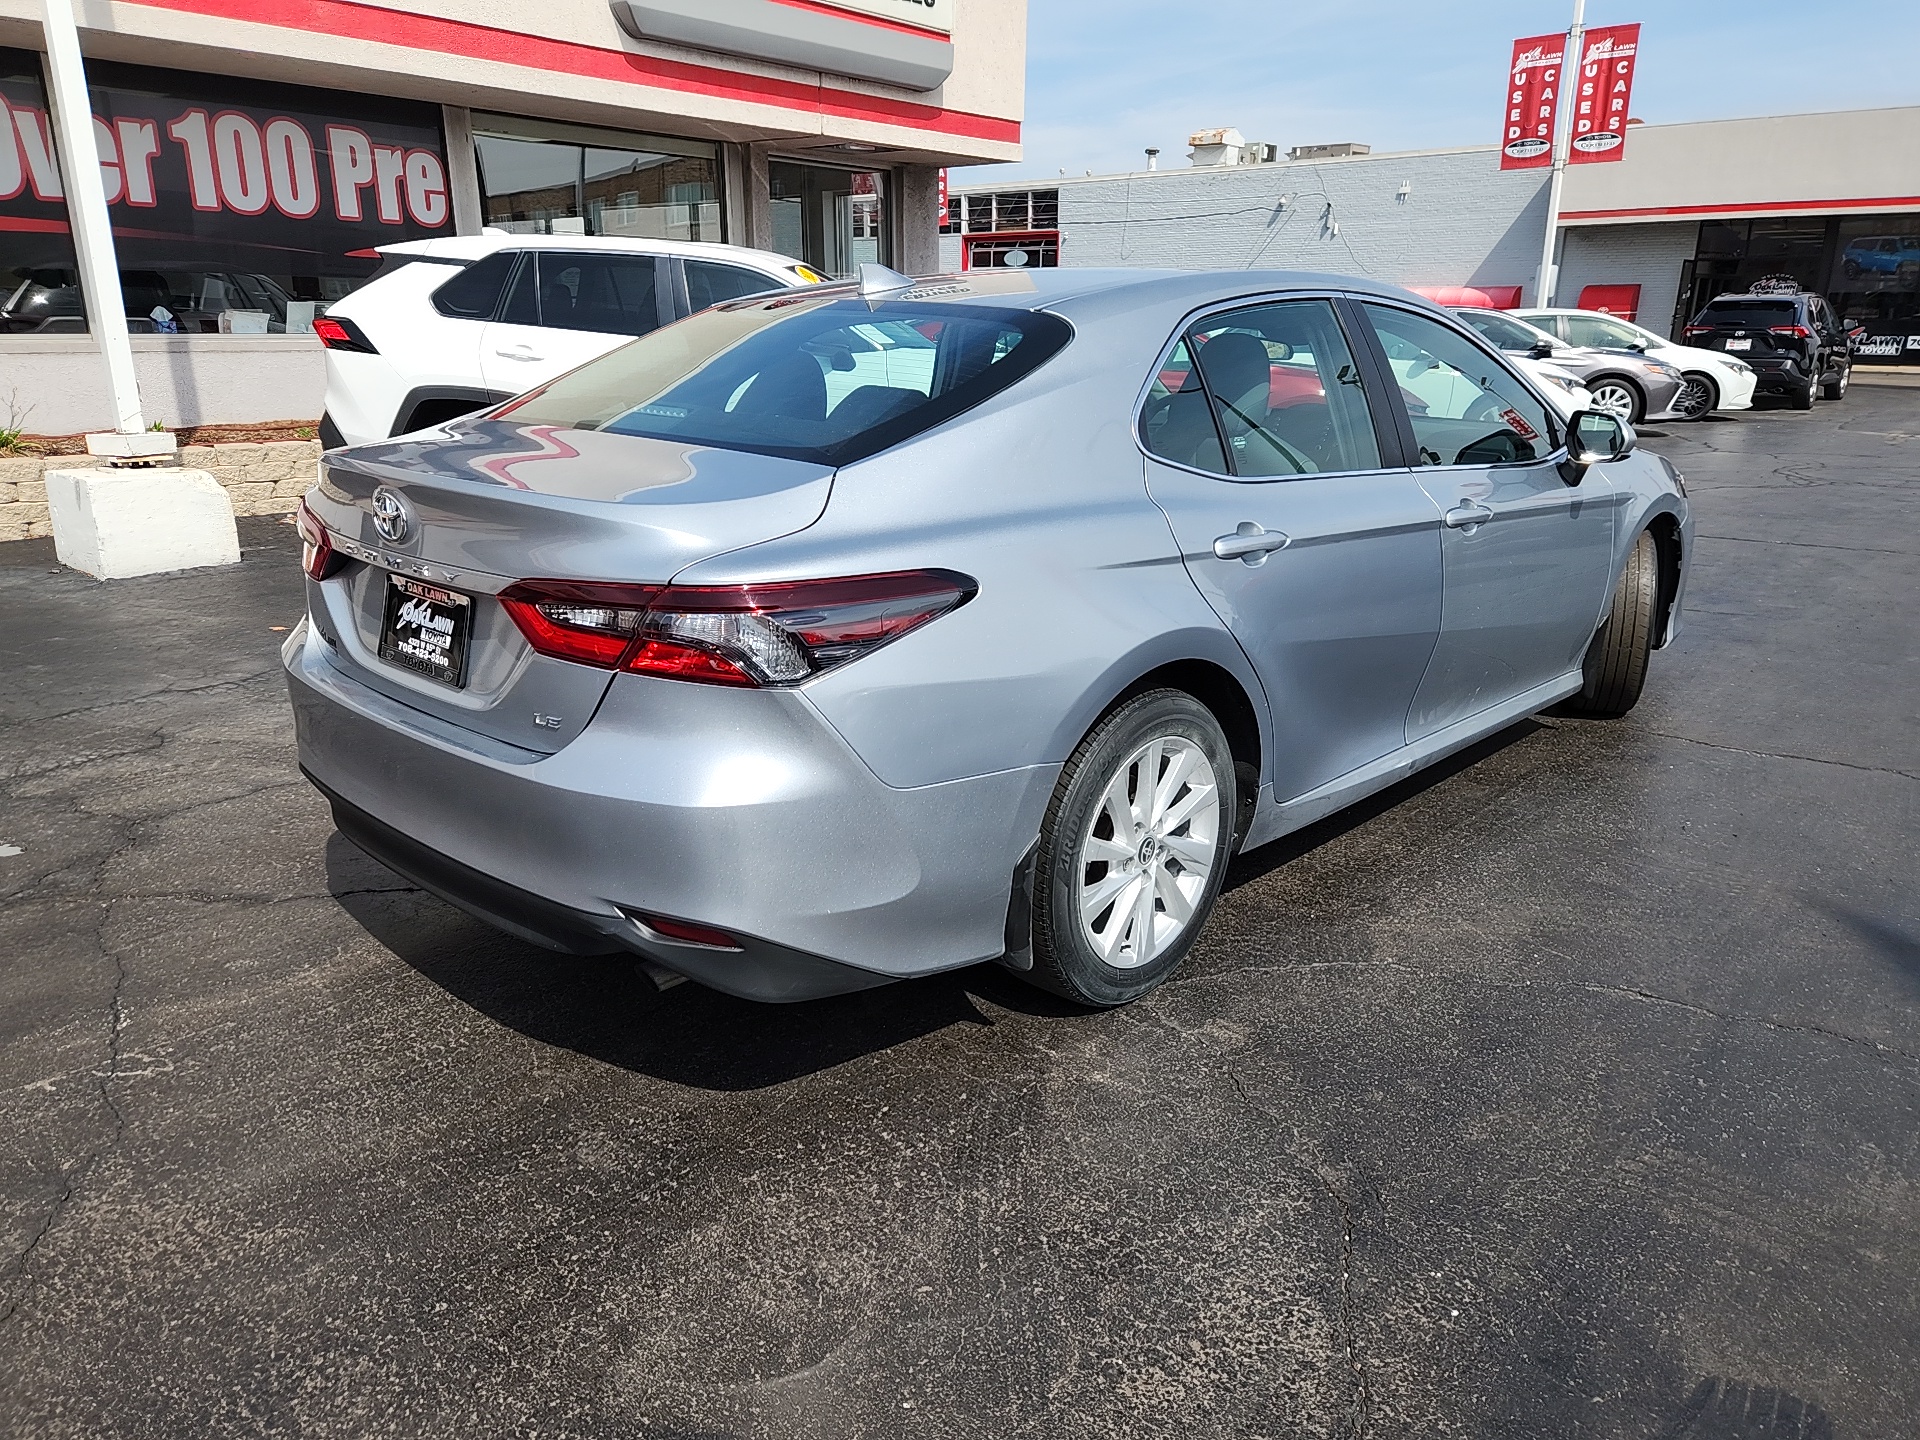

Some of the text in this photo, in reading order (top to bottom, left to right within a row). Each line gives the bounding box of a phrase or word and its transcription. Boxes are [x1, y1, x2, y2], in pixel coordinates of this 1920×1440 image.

[1541, 52, 1562, 60] LAWN
[1613, 43, 1636, 51] LAWN
[1508, 69, 1556, 139] USED CARS
[1578, 60, 1628, 132] USED CARS
[167, 107, 321, 220] 100
[325, 124, 450, 228] Pre
[1859, 346, 1897, 355] TOYOTA
[345, 542, 463, 582] CAMRY
[407, 582, 448, 603] OAK LAWN
[424, 630, 447, 645] TOYOTA
[398, 641, 449, 667] 708-423-5200
[403, 654, 435, 676] TOYOTA
[533, 712, 563, 729] LE
